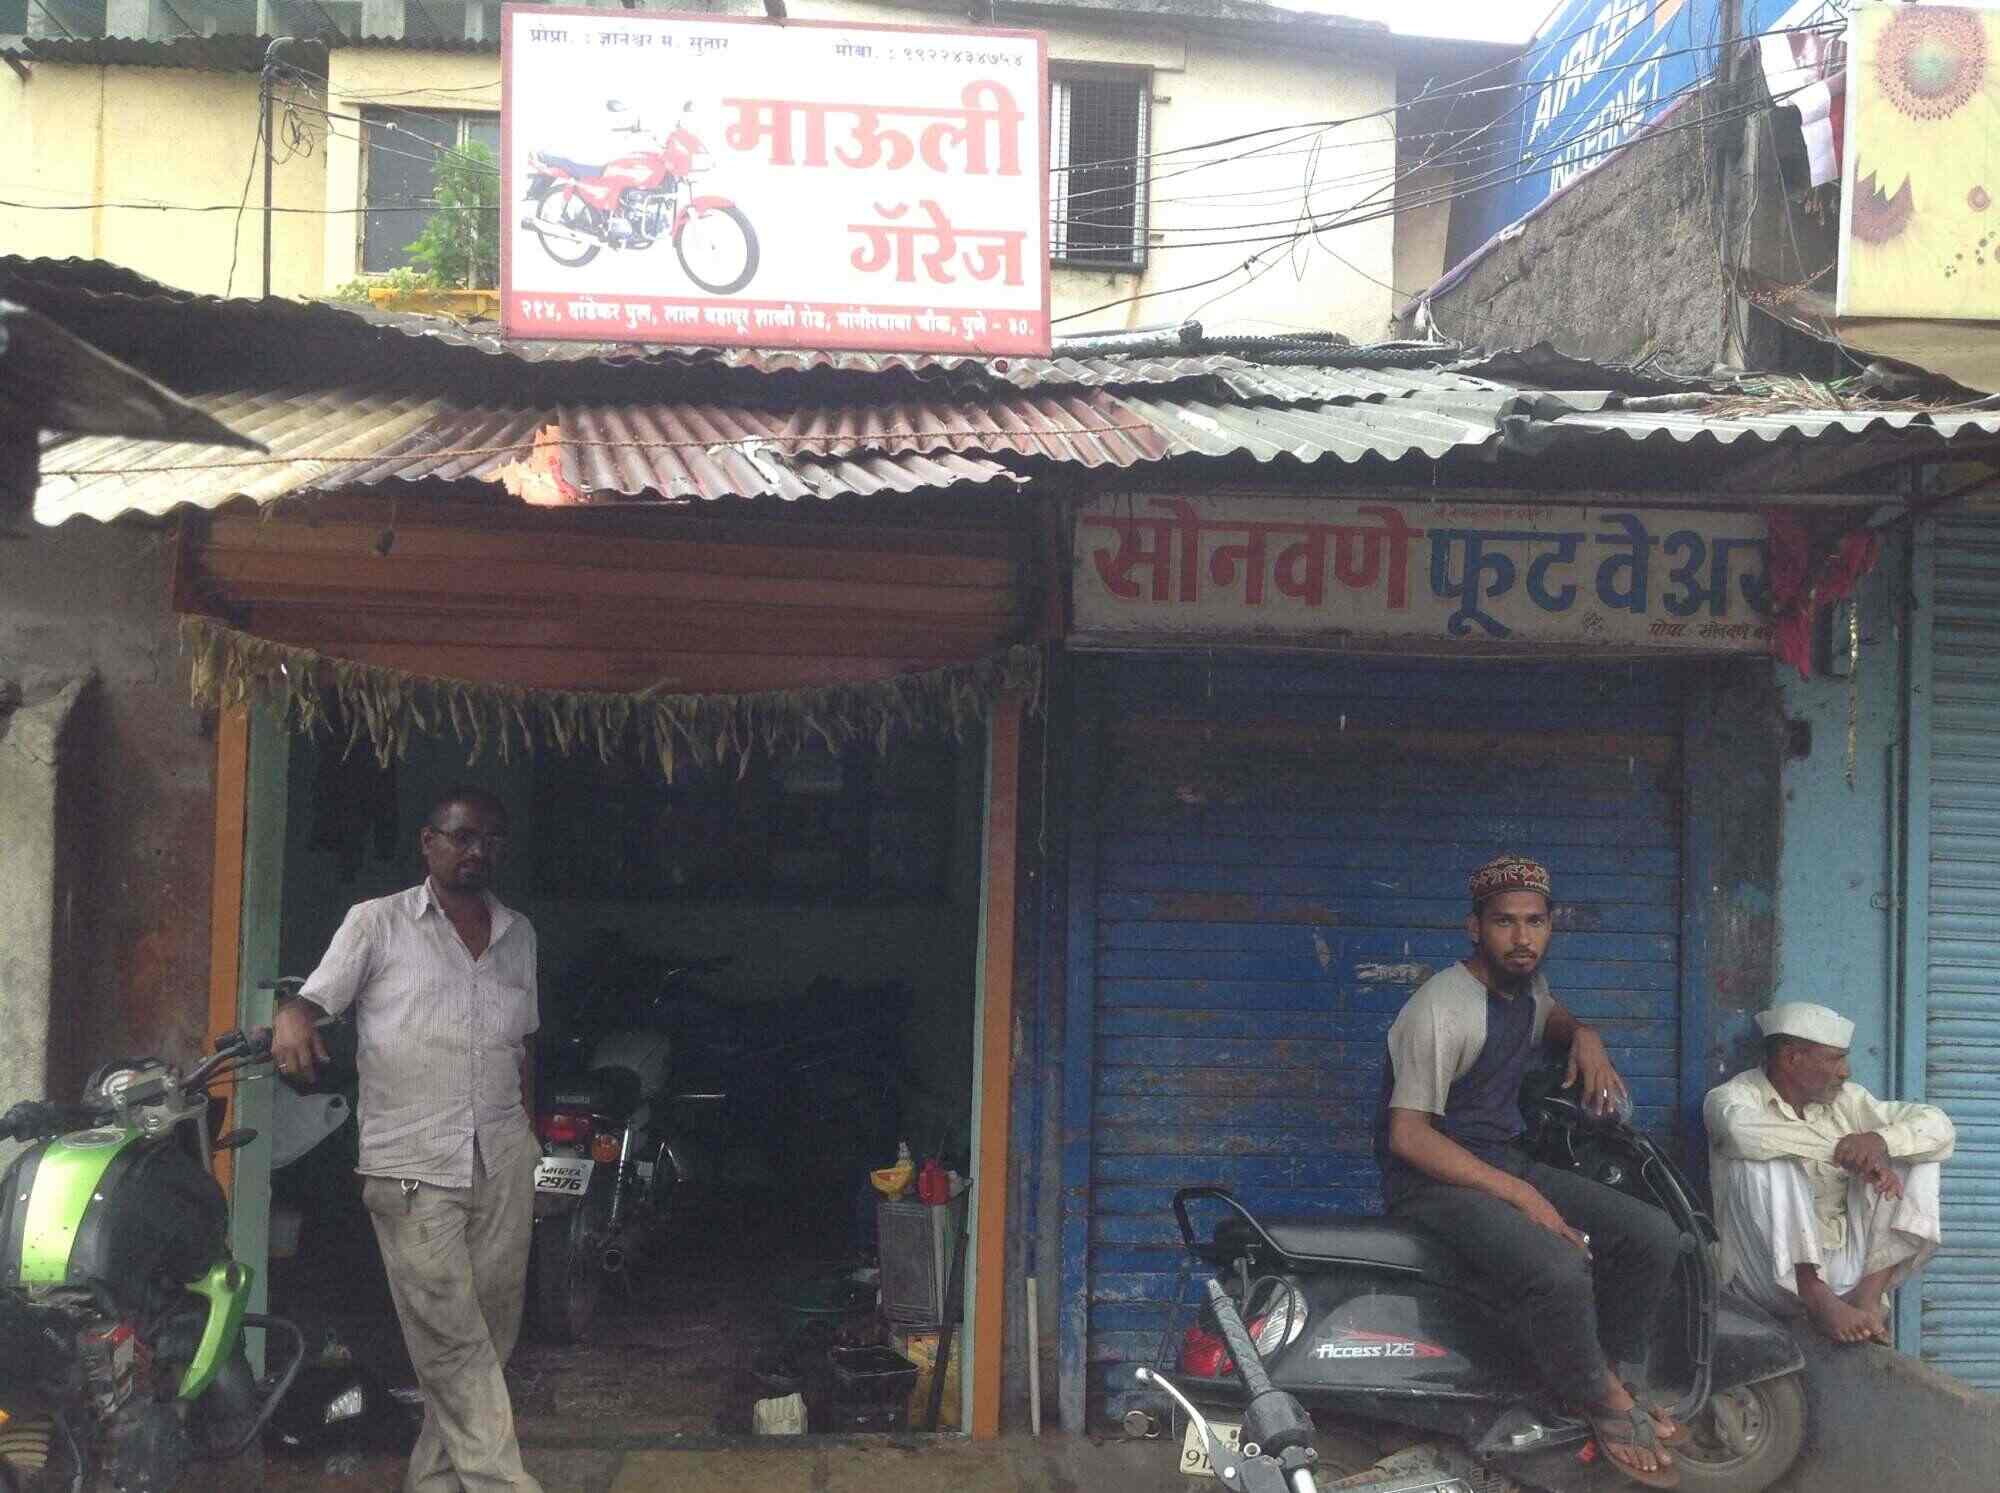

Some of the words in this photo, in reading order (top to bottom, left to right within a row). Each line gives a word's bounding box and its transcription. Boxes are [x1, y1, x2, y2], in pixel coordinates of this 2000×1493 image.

[689, 36, 729, 56] सुतार
[722, 80, 1025, 176] माऊली
[848, 199, 1026, 287] गॅरेज
[1082, 496, 1423, 611] सोनवणे
[537, 1175, 583, 1191] 2976
[1317, 1343, 1381, 1359] Access
[1385, 1343, 1415, 1357] 125
